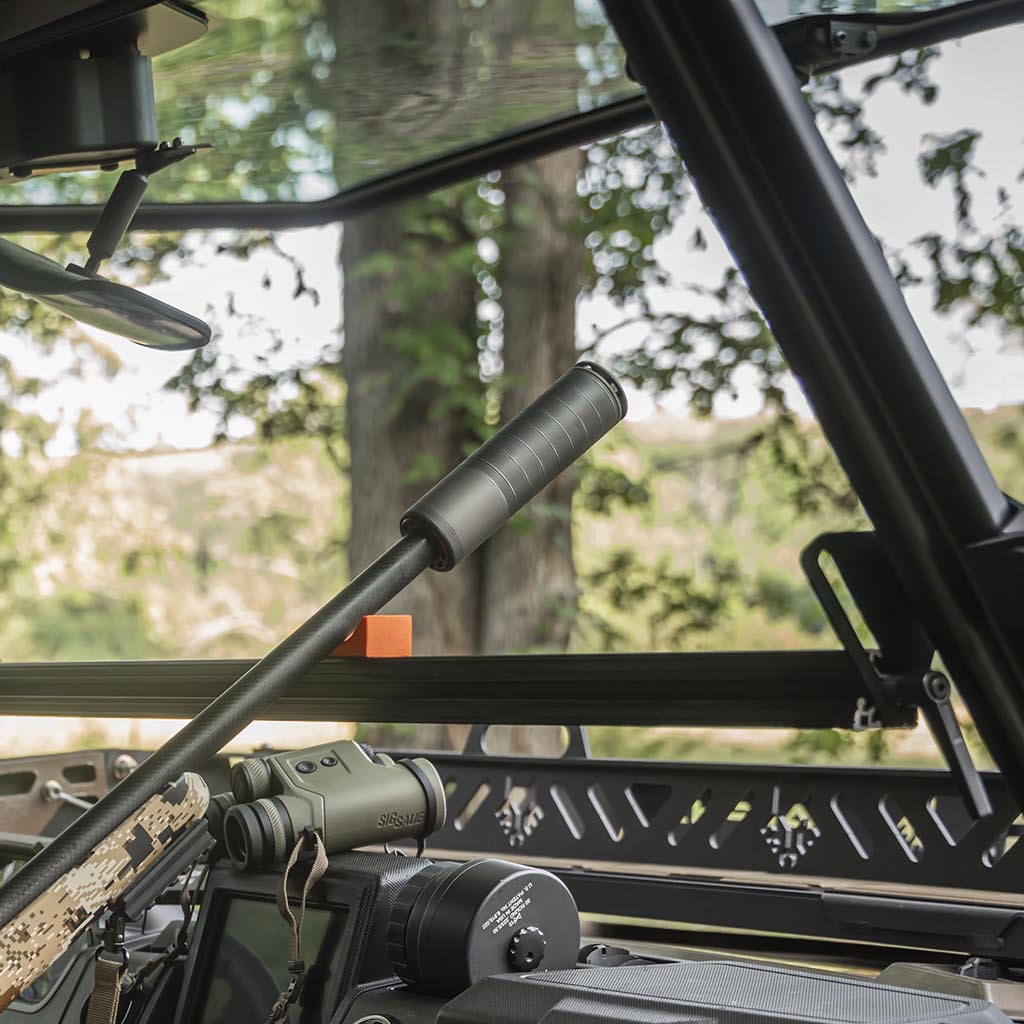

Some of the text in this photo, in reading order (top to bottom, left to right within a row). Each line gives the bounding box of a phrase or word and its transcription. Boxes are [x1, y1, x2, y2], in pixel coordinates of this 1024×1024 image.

[507, 889, 525, 906] PATENT
[495, 898, 523, 923] MADE IN USA
[509, 903, 526, 919] ROUND
